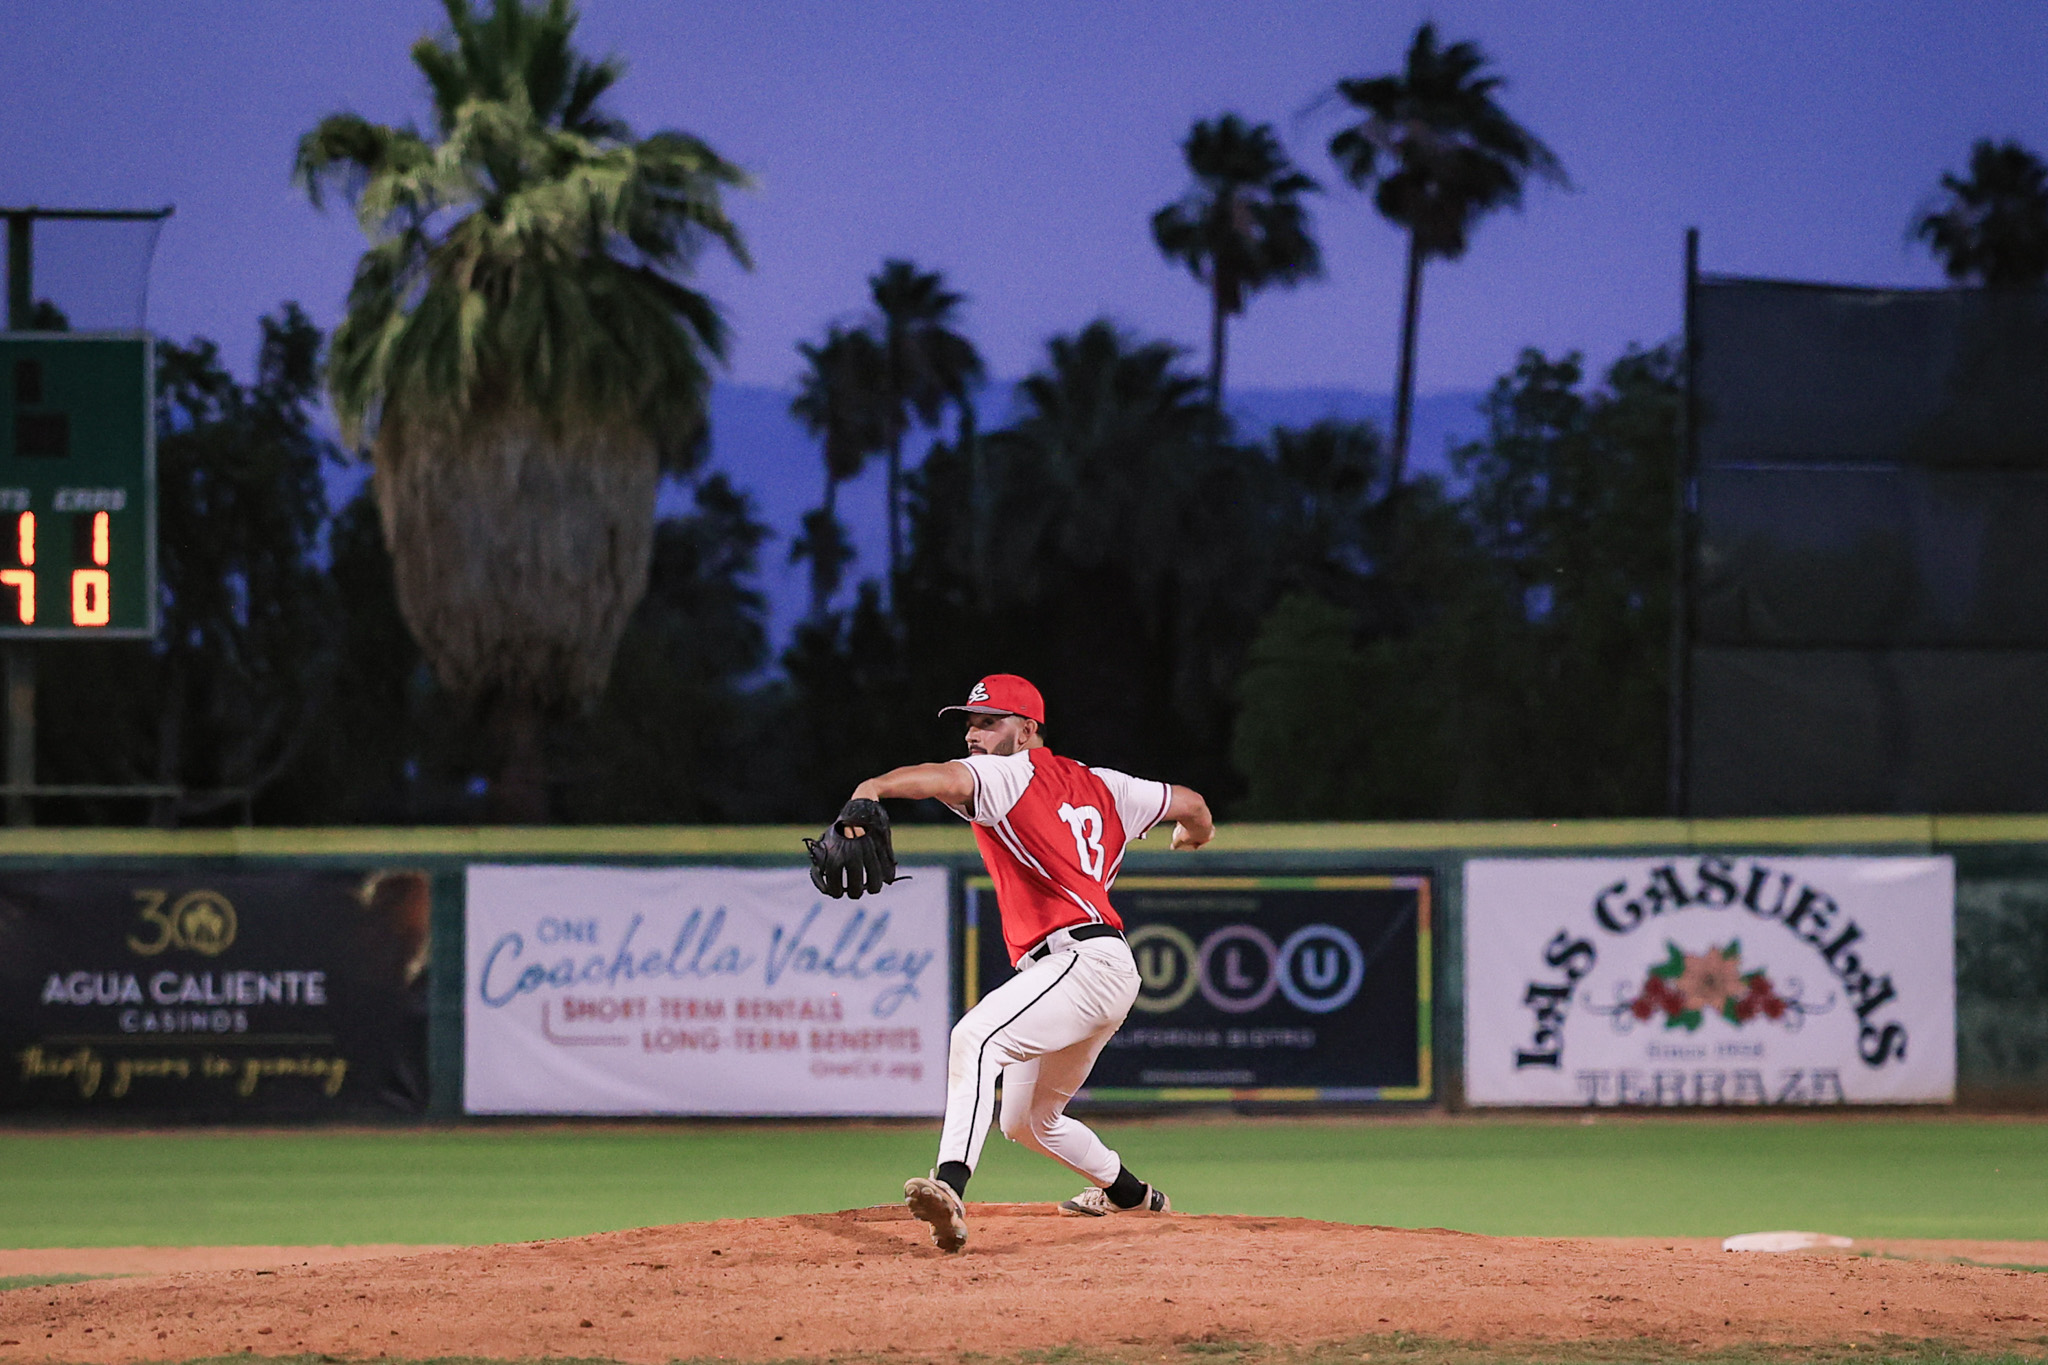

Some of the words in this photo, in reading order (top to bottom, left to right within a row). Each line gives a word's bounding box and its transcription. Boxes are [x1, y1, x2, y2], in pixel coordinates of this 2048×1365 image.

[92, 510, 110, 567] 1
[71, 568, 110, 627] 0
[1057, 801, 1106, 882] 13
[536, 917, 598, 944] ONE
[478, 906, 756, 1008] Coachella
[763, 902, 936, 1020] Valley
[42, 971, 144, 1005] AGUA
[149, 971, 327, 1006] CALIENTE
[1514, 928, 1597, 1071] LAS
[118, 1009, 248, 1033] CASINOS
[562, 997, 647, 1023] SHORT
[659, 997, 726, 1021] TERM
[734, 997, 844, 1023] RENTALS
[642, 1027, 720, 1053] LONG
[733, 1027, 799, 1053] TERM
[808, 1027, 922, 1053] BENEFITS
[1576, 1070, 1848, 1105] TERRAZA
